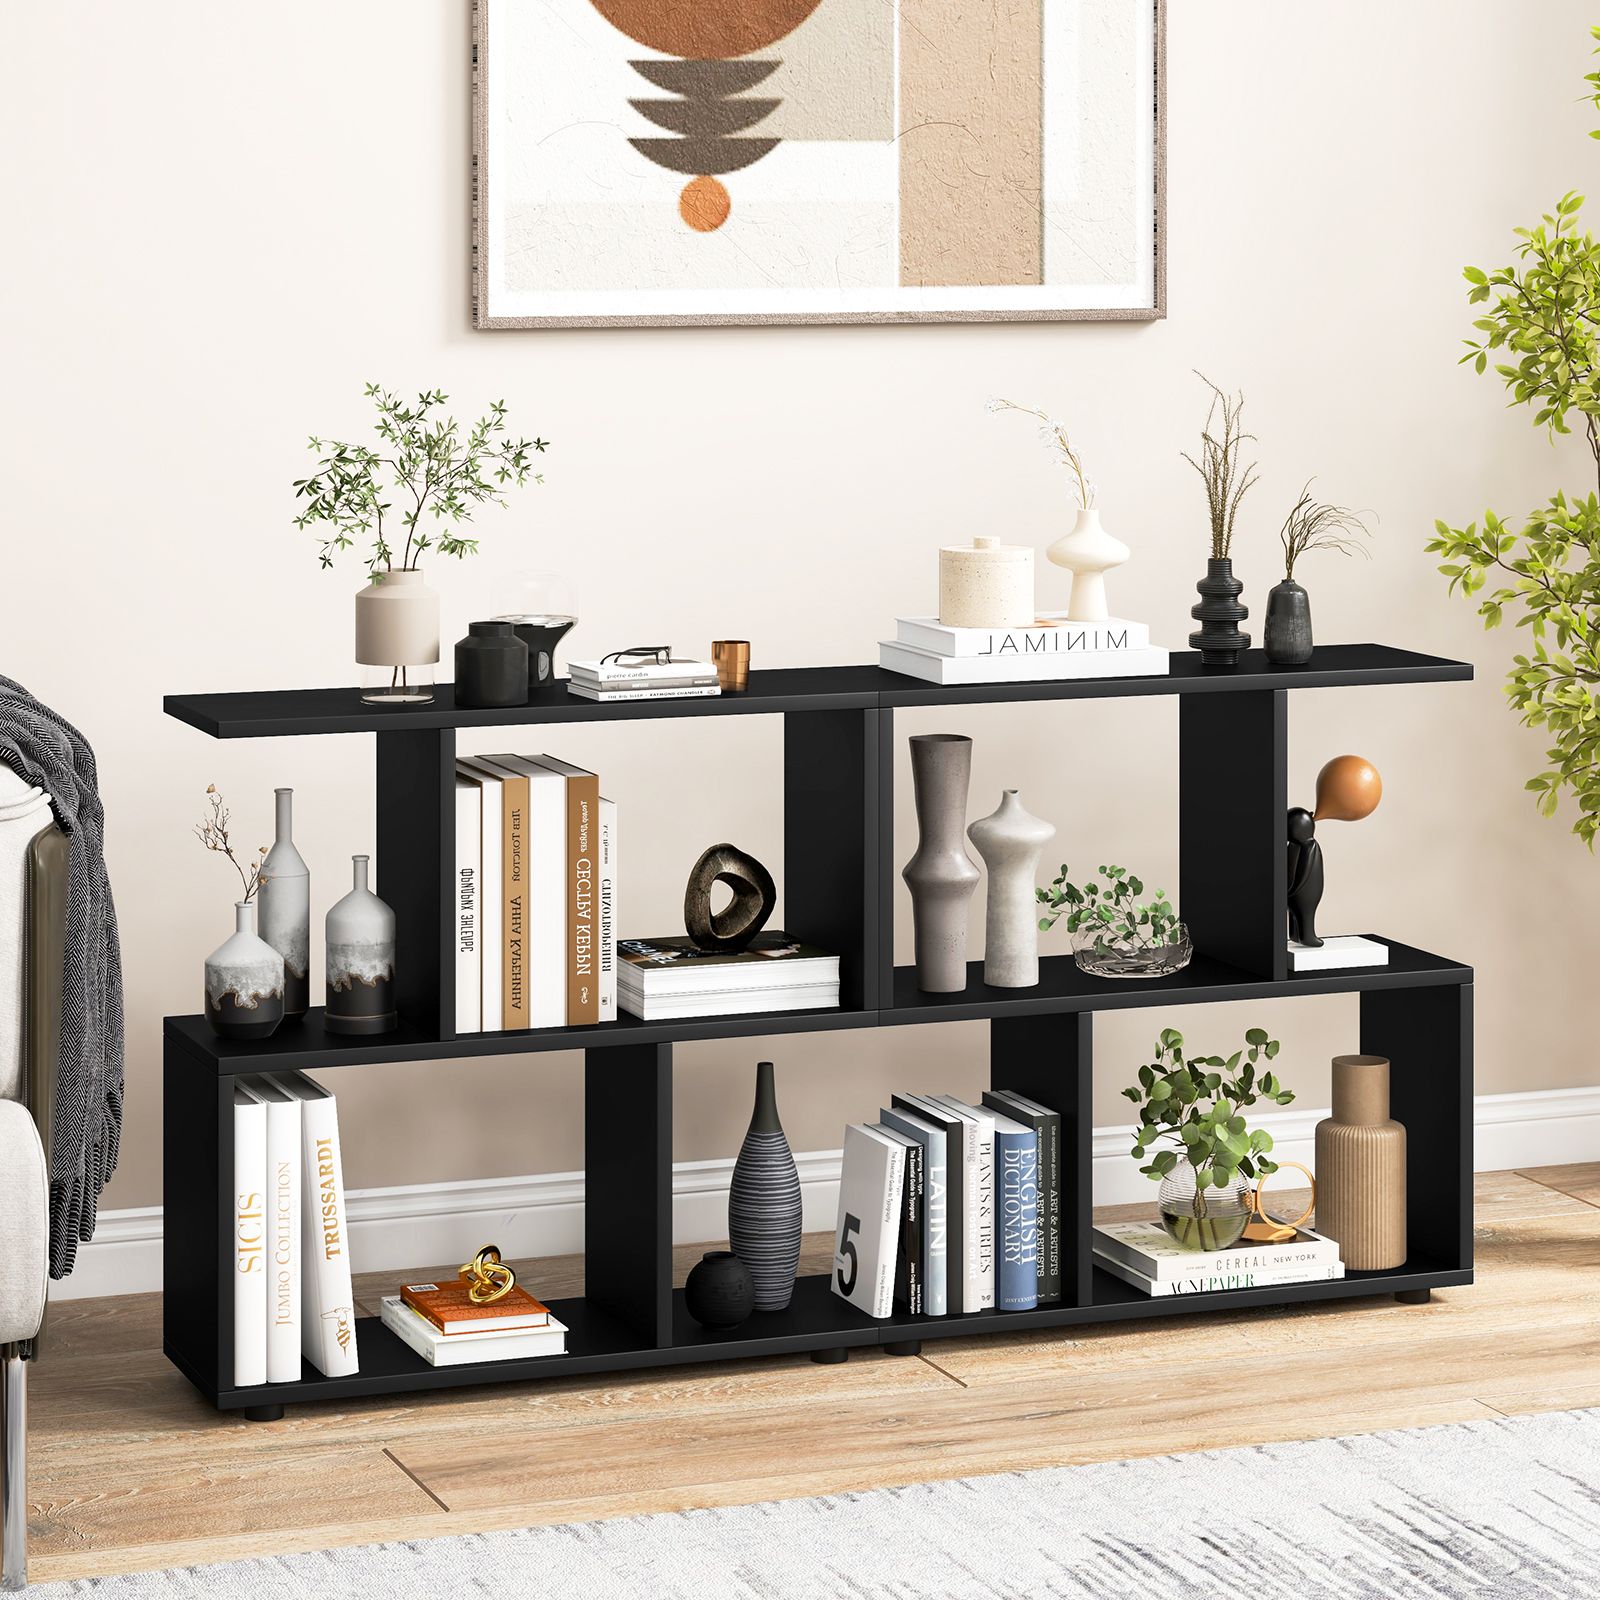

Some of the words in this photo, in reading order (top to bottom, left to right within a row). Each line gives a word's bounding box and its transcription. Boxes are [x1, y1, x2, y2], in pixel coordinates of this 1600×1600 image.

[966, 1124, 978, 1163] Moving
[316, 1137, 341, 1261] TRUSSARDI
[980, 1143, 991, 1203] PLANTS
[1050, 1189, 1059, 1214] ART
[275, 1161, 291, 1263] COLLECTION
[929, 1166, 946, 1249] LATIN
[1004, 1148, 1021, 1266] DICTIONARY
[1020, 1147, 1037, 1265] ENGLISH
[1036, 1190, 1045, 1215] ART
[237, 1192, 262, 1274] SICIS
[836, 1211, 861, 1297] 5
[980, 1222, 991, 1273] TREES
[1036, 1228, 1045, 1277] ARTISTS
[1050, 1227, 1059, 1276] ARTISTS
[1216, 1255, 1267, 1271] CEREAL
[1274, 1255, 1293, 1264] NEW
[1295, 1253, 1318, 1262] YORK
[275, 1271, 295, 1326] JUMBO
